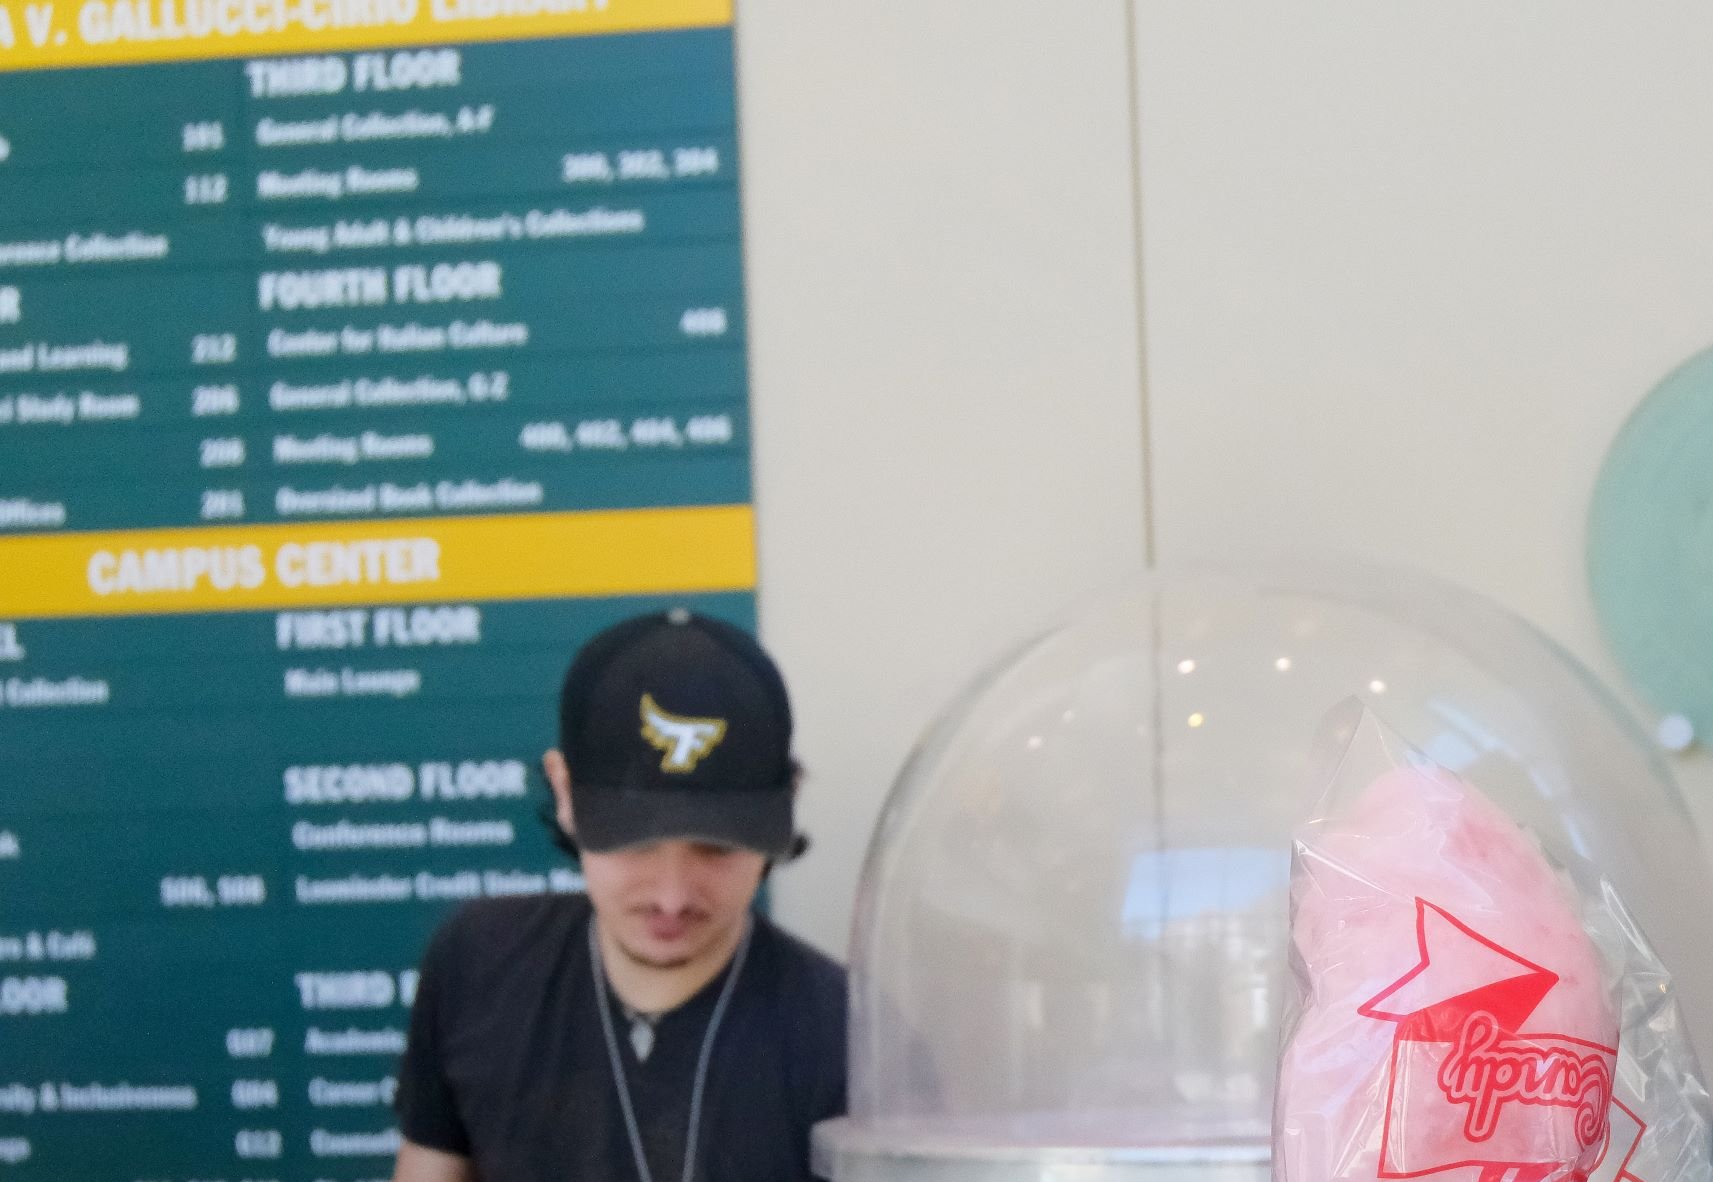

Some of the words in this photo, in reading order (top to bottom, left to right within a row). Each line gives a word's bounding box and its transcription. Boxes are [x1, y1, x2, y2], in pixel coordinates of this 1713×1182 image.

[246, 57, 347, 99] THIRD
[352, 49, 462, 92] FLOOR
[256, 117, 339, 147] General
[256, 169, 342, 201] Meeting
[345, 165, 420, 195] Rooms
[63, 231, 169, 262] Collection
[262, 222, 331, 255] Young
[333, 218, 390, 249] Adult
[392, 214, 412, 248] &
[414, 211, 524, 245] Children's
[524, 206, 646, 239] Collections
[258, 269, 390, 312] FOURTH
[392, 260, 503, 304] FLOOR
[37, 338, 130, 373] Learning
[266, 327, 339, 358] Center
[340, 323, 374, 354] for
[375, 322, 447, 352] Italian
[448, 319, 530, 350] Culture
[16, 392, 76, 425] Study
[78, 390, 142, 420] Room
[269, 378, 352, 411] General
[273, 433, 359, 464] Meeting
[360, 430, 435, 460] Rooms
[275, 486, 377, 516] Oversized
[378, 481, 435, 513] Book
[435, 477, 544, 508] Collection
[86, 546, 267, 597] CAMPUS
[274, 536, 442, 589] CENTER
[275, 610, 369, 651] FIRST
[372, 604, 482, 647] FLOOR
[6, 673, 110, 706] Collection
[284, 668, 339, 699] Main
[340, 666, 422, 698] Lounge
[283, 765, 415, 804] SECOND
[418, 758, 528, 801] FLOOR
[291, 819, 428, 850] Conference
[428, 815, 515, 846] Rooms
[294, 874, 414, 905] Leominster
[414, 869, 482, 902] Credit
[482, 869, 549, 897] Union
[294, 970, 396, 1010] THIRD
[58, 1081, 198, 1112] Inclusiveness
[1437, 1008, 1610, 1149] Candy
